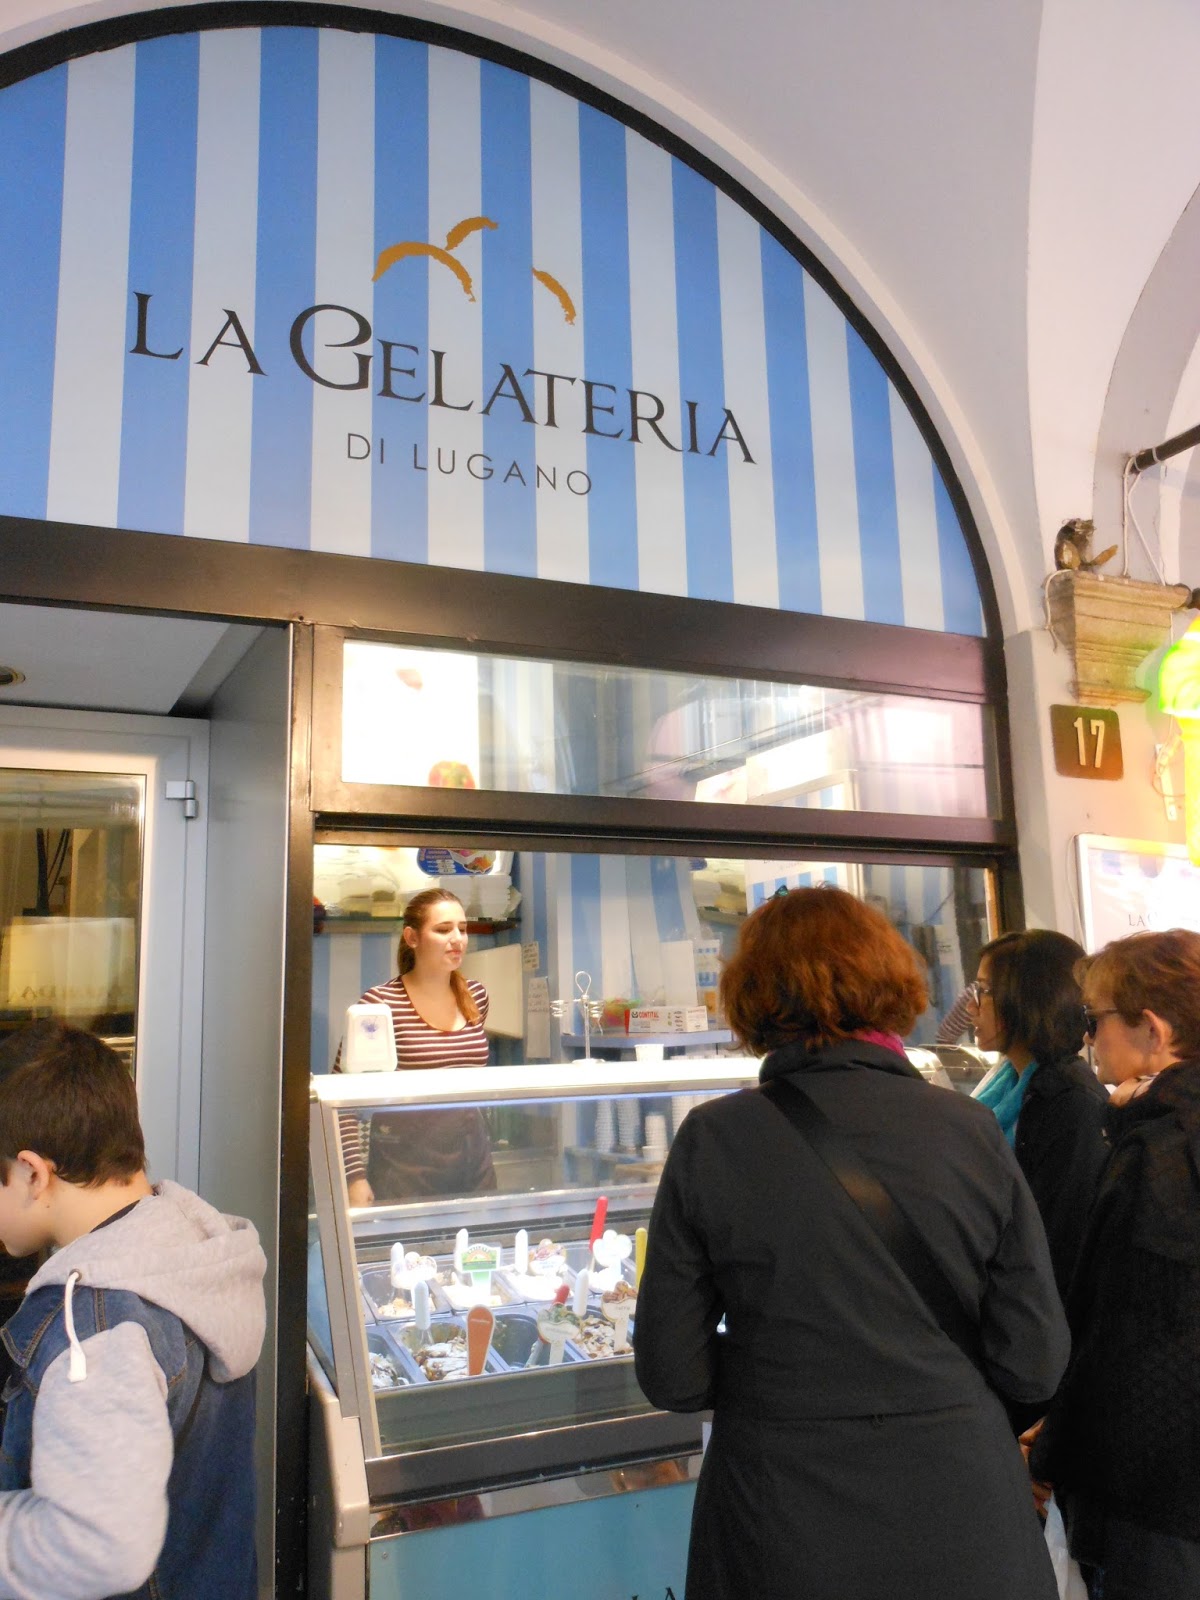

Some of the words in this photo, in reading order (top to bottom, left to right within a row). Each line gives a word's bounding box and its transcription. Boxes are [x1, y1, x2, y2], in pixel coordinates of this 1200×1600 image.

[129, 291, 268, 376] LA
[289, 303, 757, 465] GELATERIA
[347, 432, 384, 464] DI
[413, 443, 592, 496] LUGANO
[1073, 716, 1105, 769] 17
[1128, 913, 1146, 927] LA
